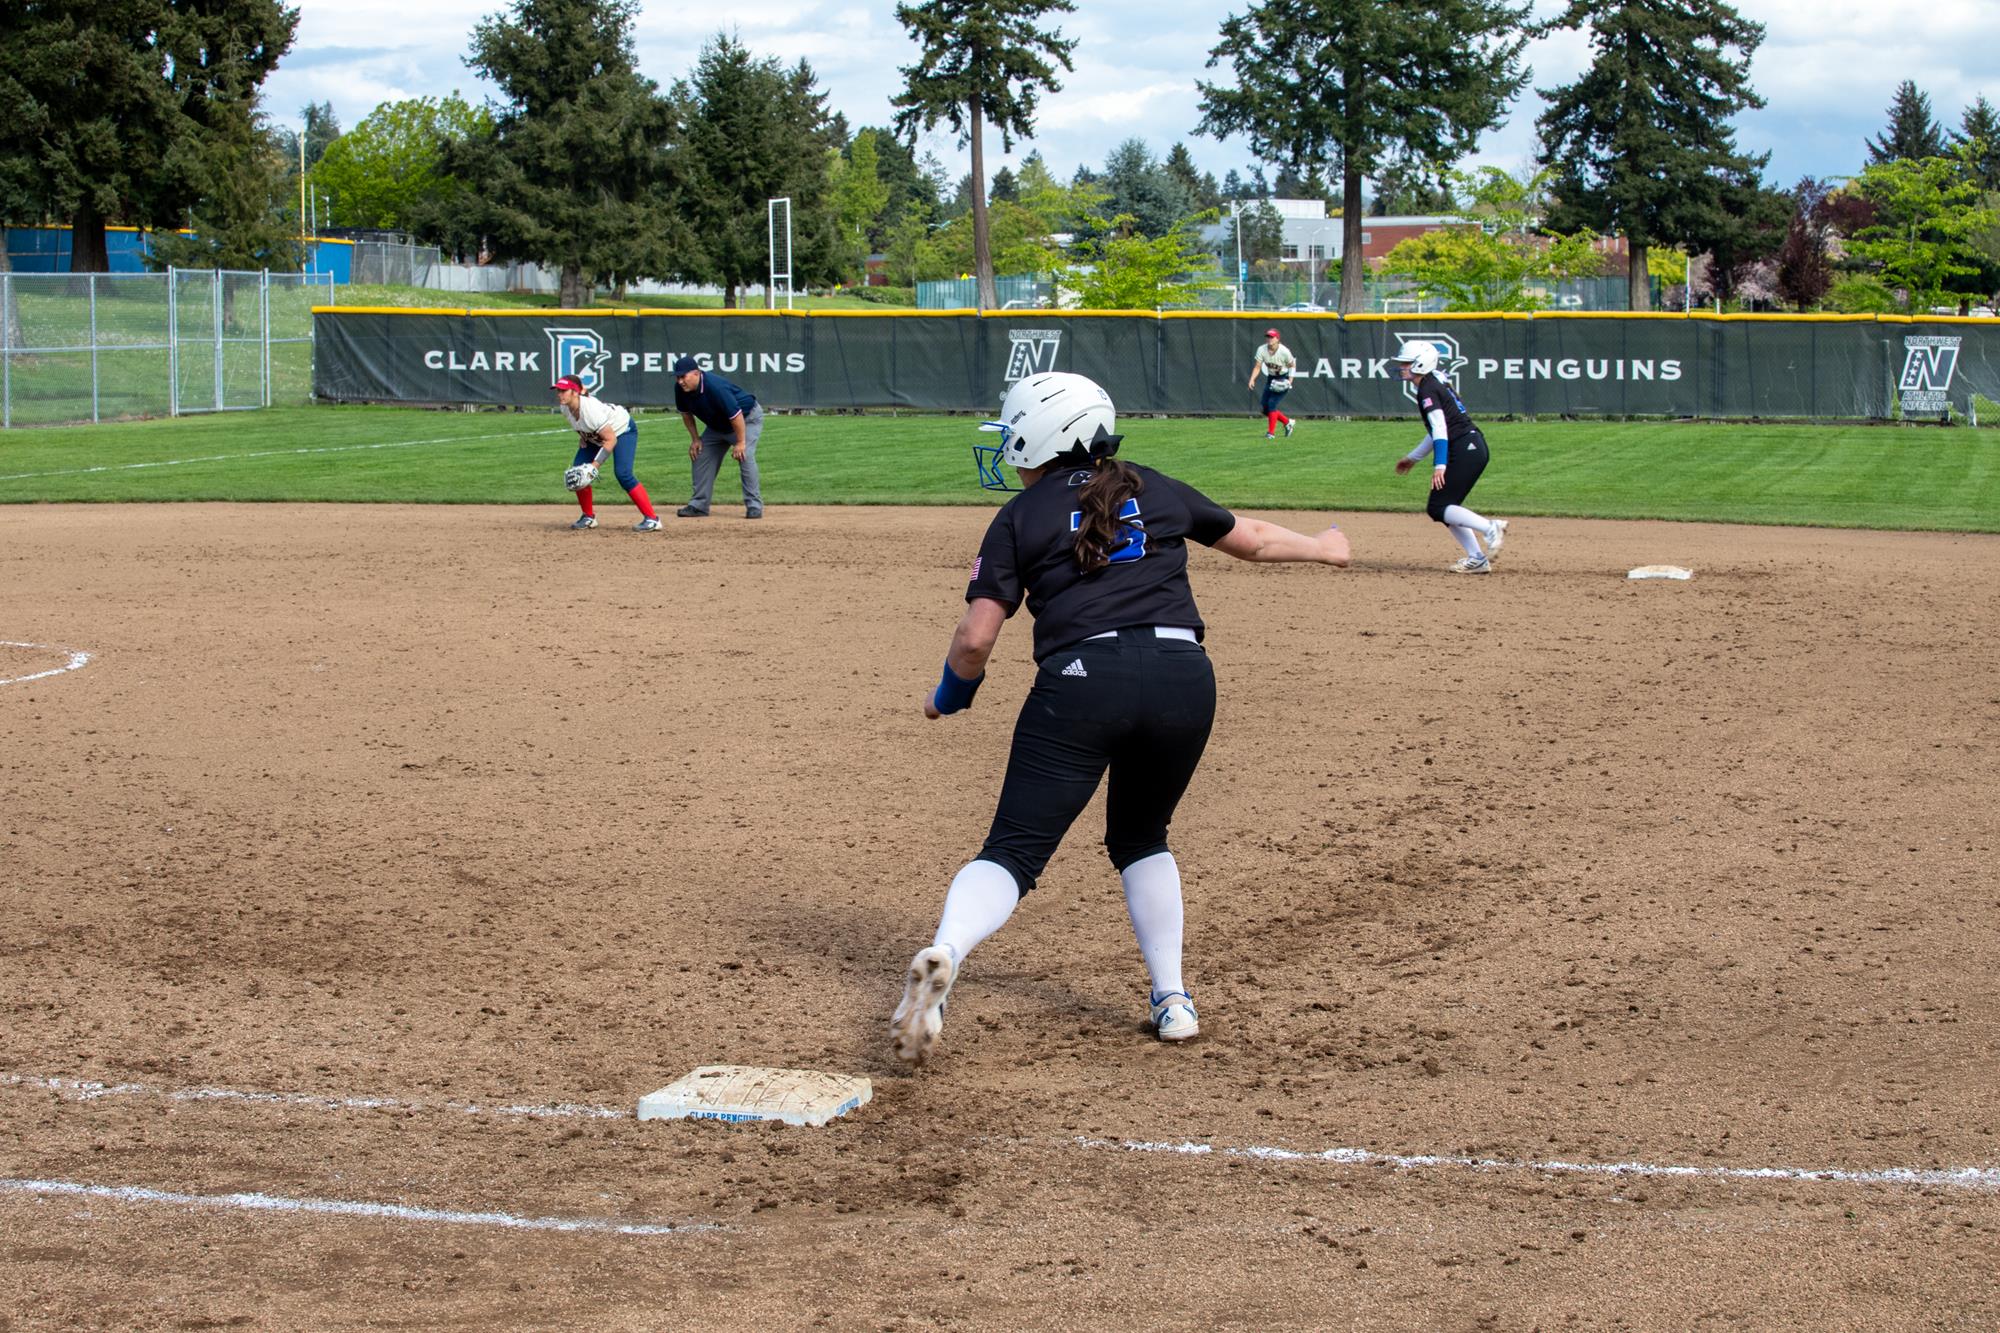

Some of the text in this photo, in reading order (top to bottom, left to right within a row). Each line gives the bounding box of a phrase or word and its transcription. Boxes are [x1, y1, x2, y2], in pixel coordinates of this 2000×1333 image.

[1904, 335, 1962, 347] NORTHWEST
[424, 350, 540, 371] CLARK
[1260, 357, 1391, 378] LARK
[1478, 358, 1682, 380] PENGUINS
[1061, 669, 1088, 677] adidas
